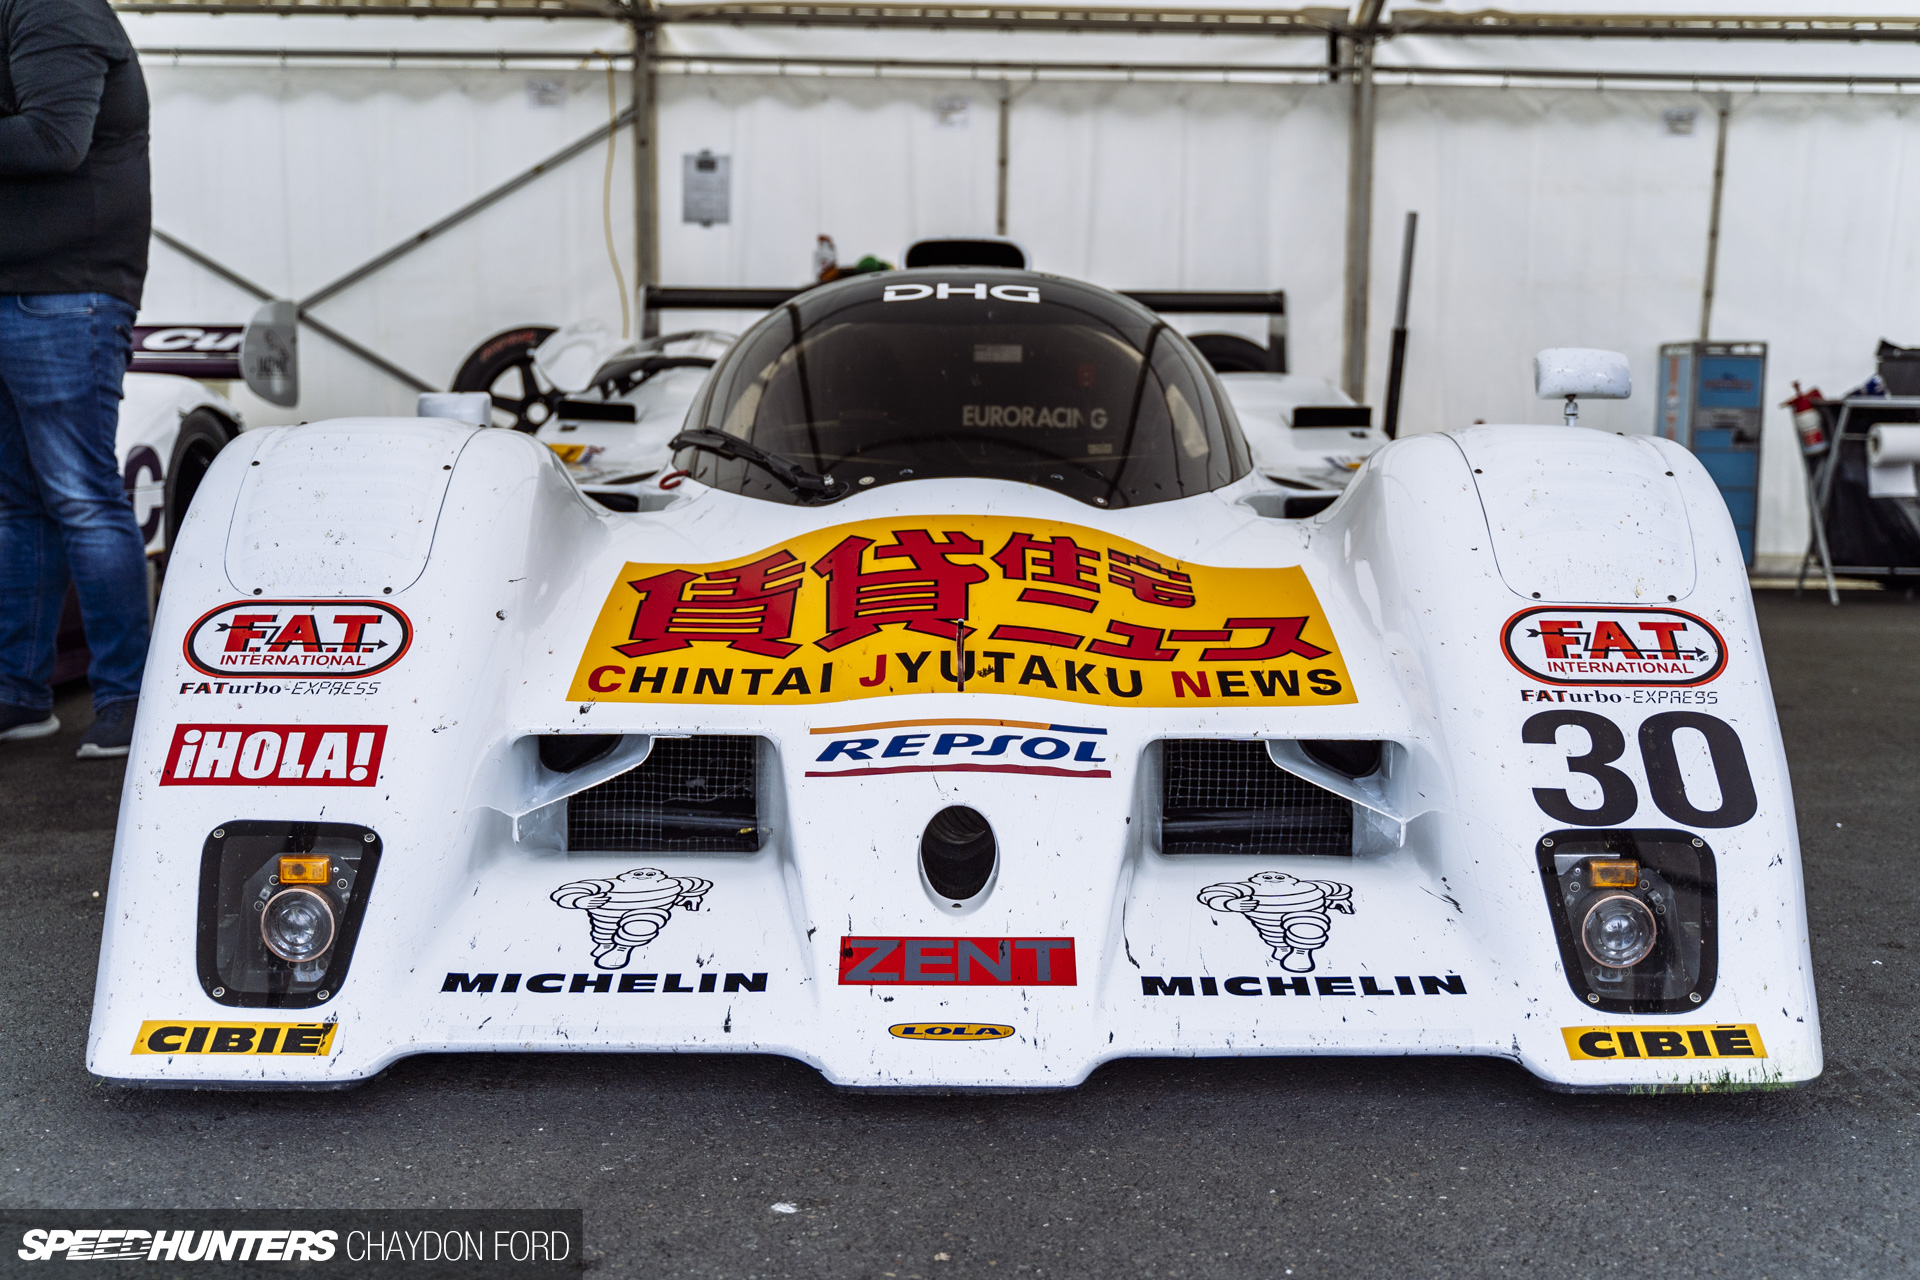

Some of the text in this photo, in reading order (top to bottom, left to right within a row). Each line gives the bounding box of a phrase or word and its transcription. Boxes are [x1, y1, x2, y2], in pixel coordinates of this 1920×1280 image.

[883, 283, 1040, 303] DHG
[219, 654, 366, 666] INTERNATIONAL
[1547, 661, 1694, 674] INTERNATIONAL
[587, 650, 1343, 698] CHINTAI JYUTAKU NEWS
[173, 729, 376, 782] ¡HOLA!
[815, 733, 1107, 762] REPSOL
[1521, 709, 1758, 829] 30
[845, 940, 1071, 982] ZENT
[440, 972, 768, 994] MICHELIN
[1140, 975, 1468, 997] MICHELIN
[901, 1026, 1003, 1036] LOLA
